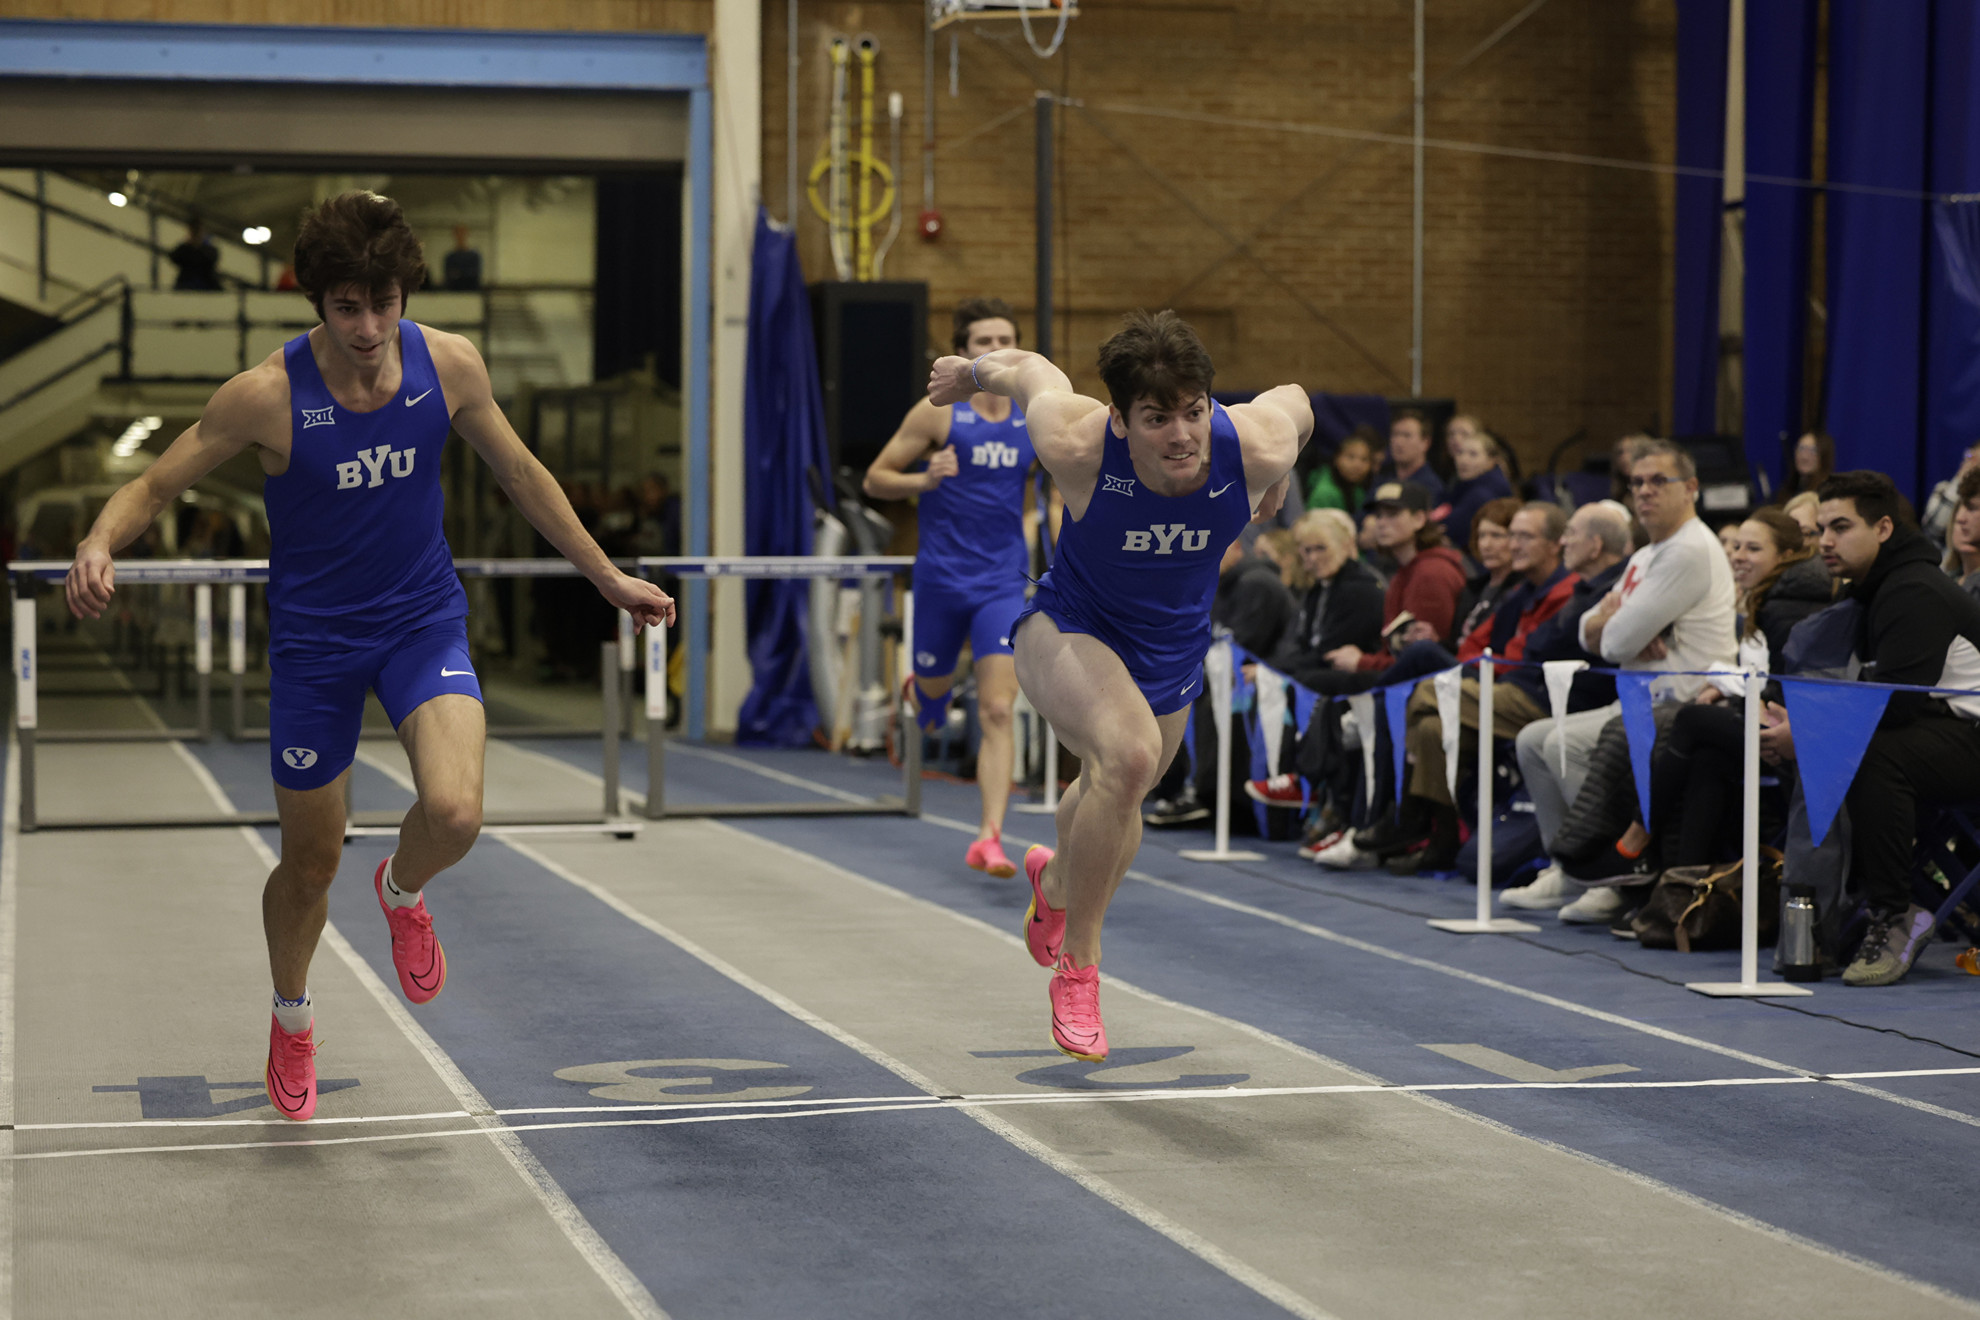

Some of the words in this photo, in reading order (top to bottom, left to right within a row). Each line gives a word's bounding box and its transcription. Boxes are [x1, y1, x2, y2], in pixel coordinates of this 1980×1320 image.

[301, 405, 336, 429] XII
[336, 444, 416, 490] BYU
[971, 441, 1019, 469] BYU
[1102, 474, 1135, 497] XII
[1122, 523, 1211, 555] BYU
[286, 749, 312, 767] Y
[553, 1058, 814, 1102] 3
[967, 1046, 1250, 1090] 2
[1415, 1043, 1642, 1082] 1
[92, 1075, 361, 1118] 4
